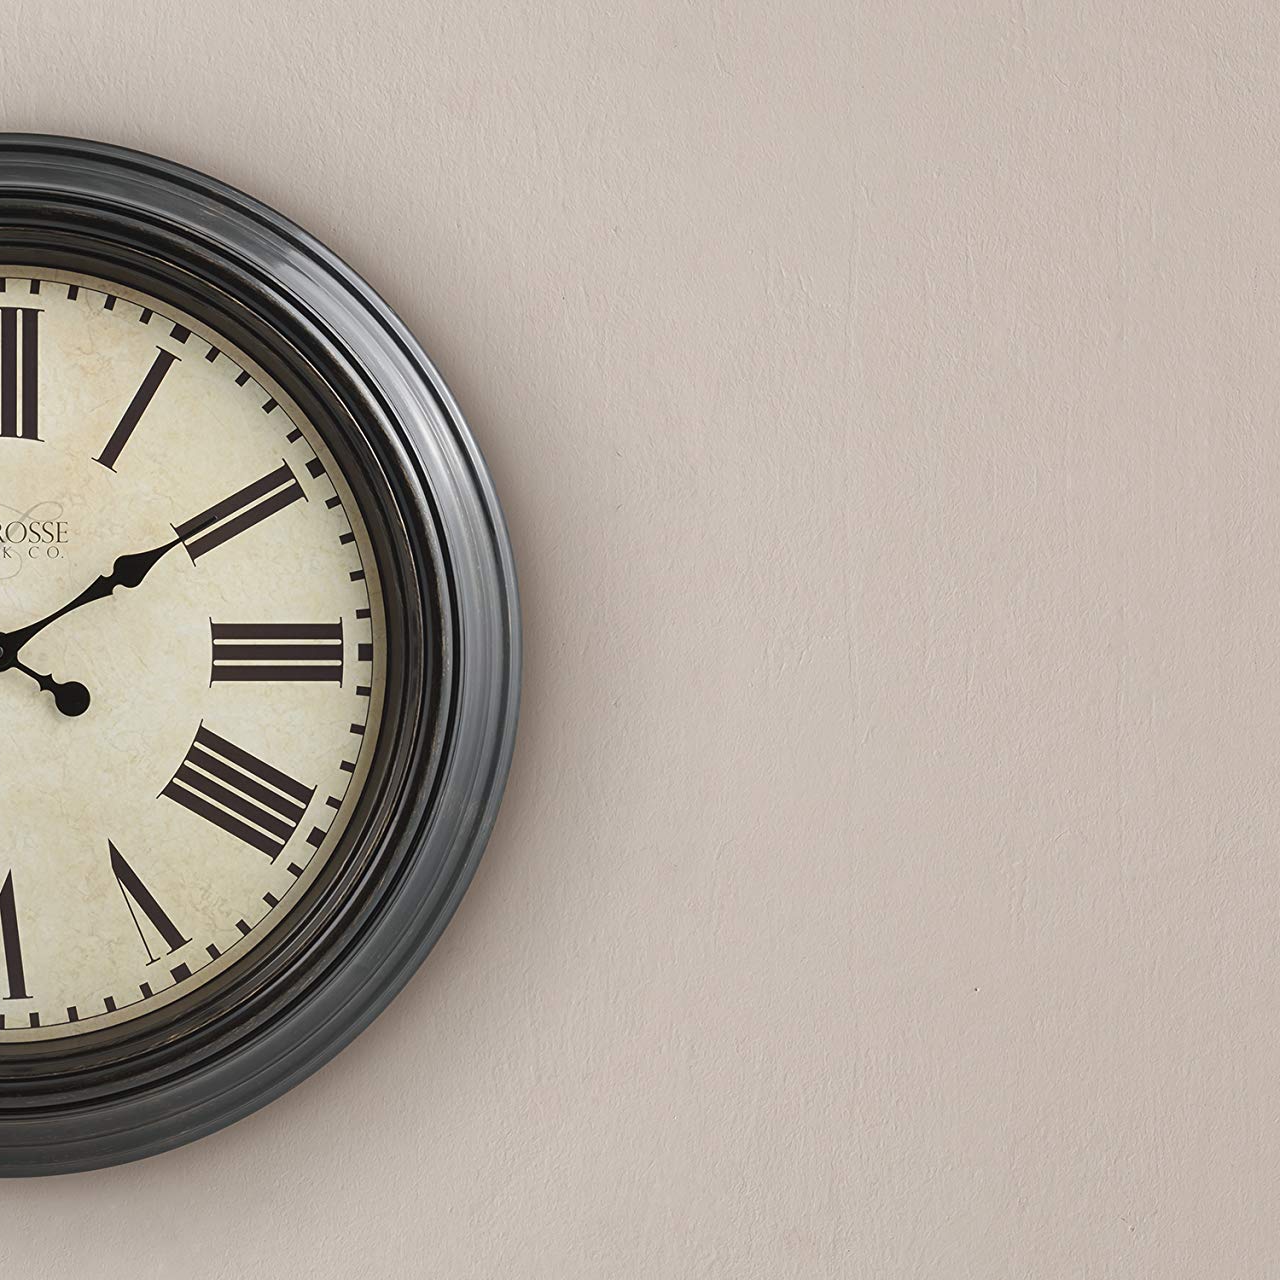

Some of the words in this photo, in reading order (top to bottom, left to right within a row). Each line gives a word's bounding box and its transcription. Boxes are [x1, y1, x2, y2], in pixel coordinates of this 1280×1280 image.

[91, 346, 182, 473] I
[28, 545, 64, 559] CO.
[172, 458, 309, 567] II
[209, 617, 344, 688] III
[156, 719, 318, 865] IIII
[108, 838, 192, 966] V
